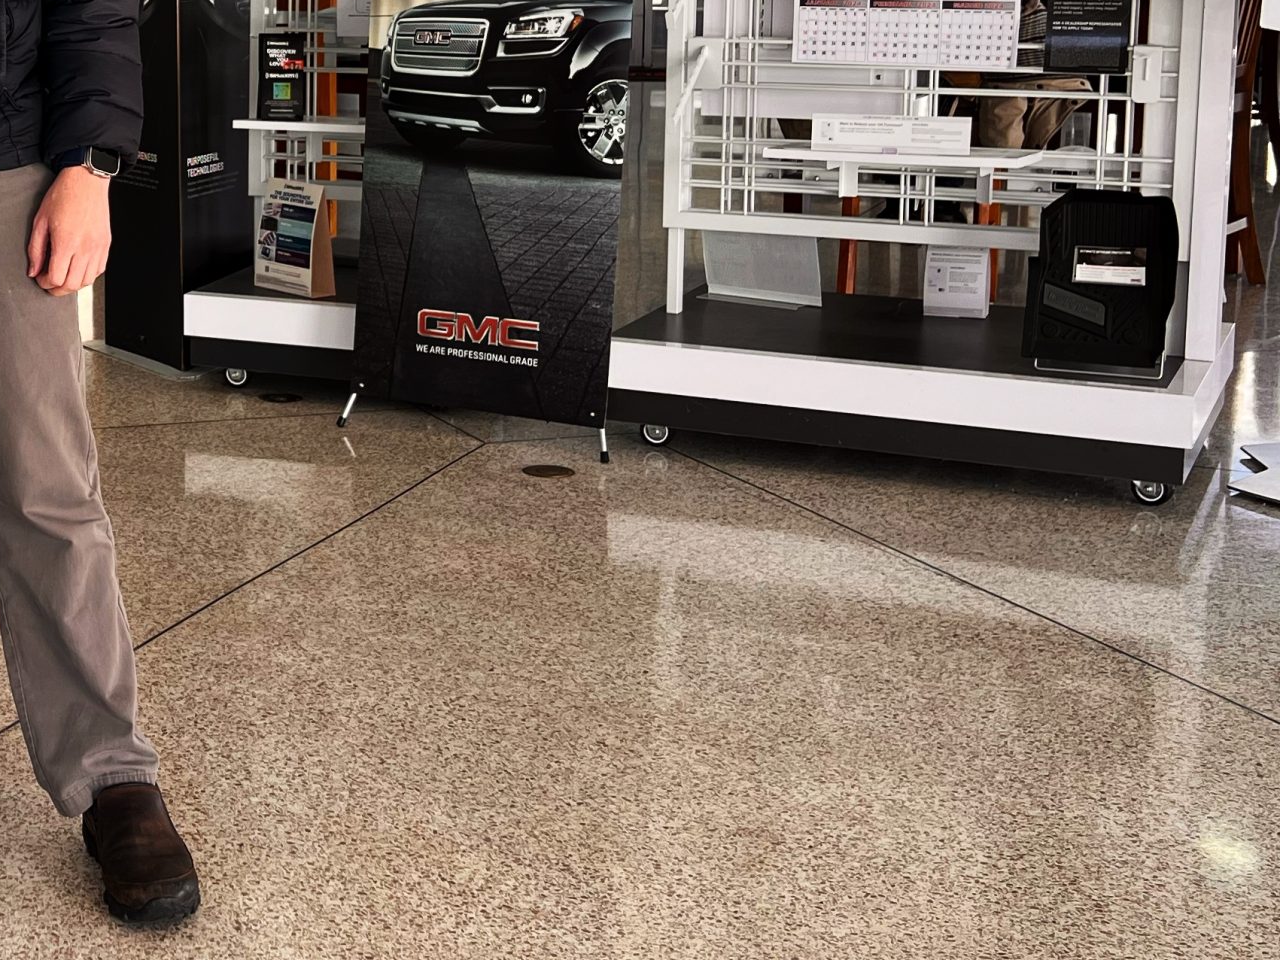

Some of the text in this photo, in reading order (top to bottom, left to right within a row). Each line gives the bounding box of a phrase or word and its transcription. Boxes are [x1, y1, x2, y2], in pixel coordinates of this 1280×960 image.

[414, 30, 452, 45] GMC
[186, 152, 220, 167] PURPOSEFUL
[186, 162, 225, 178] TECHNOLOGIES
[416, 308, 540, 351] GMC
[416, 344, 539, 367] WE ARE PROFESSIONAL GRADE
